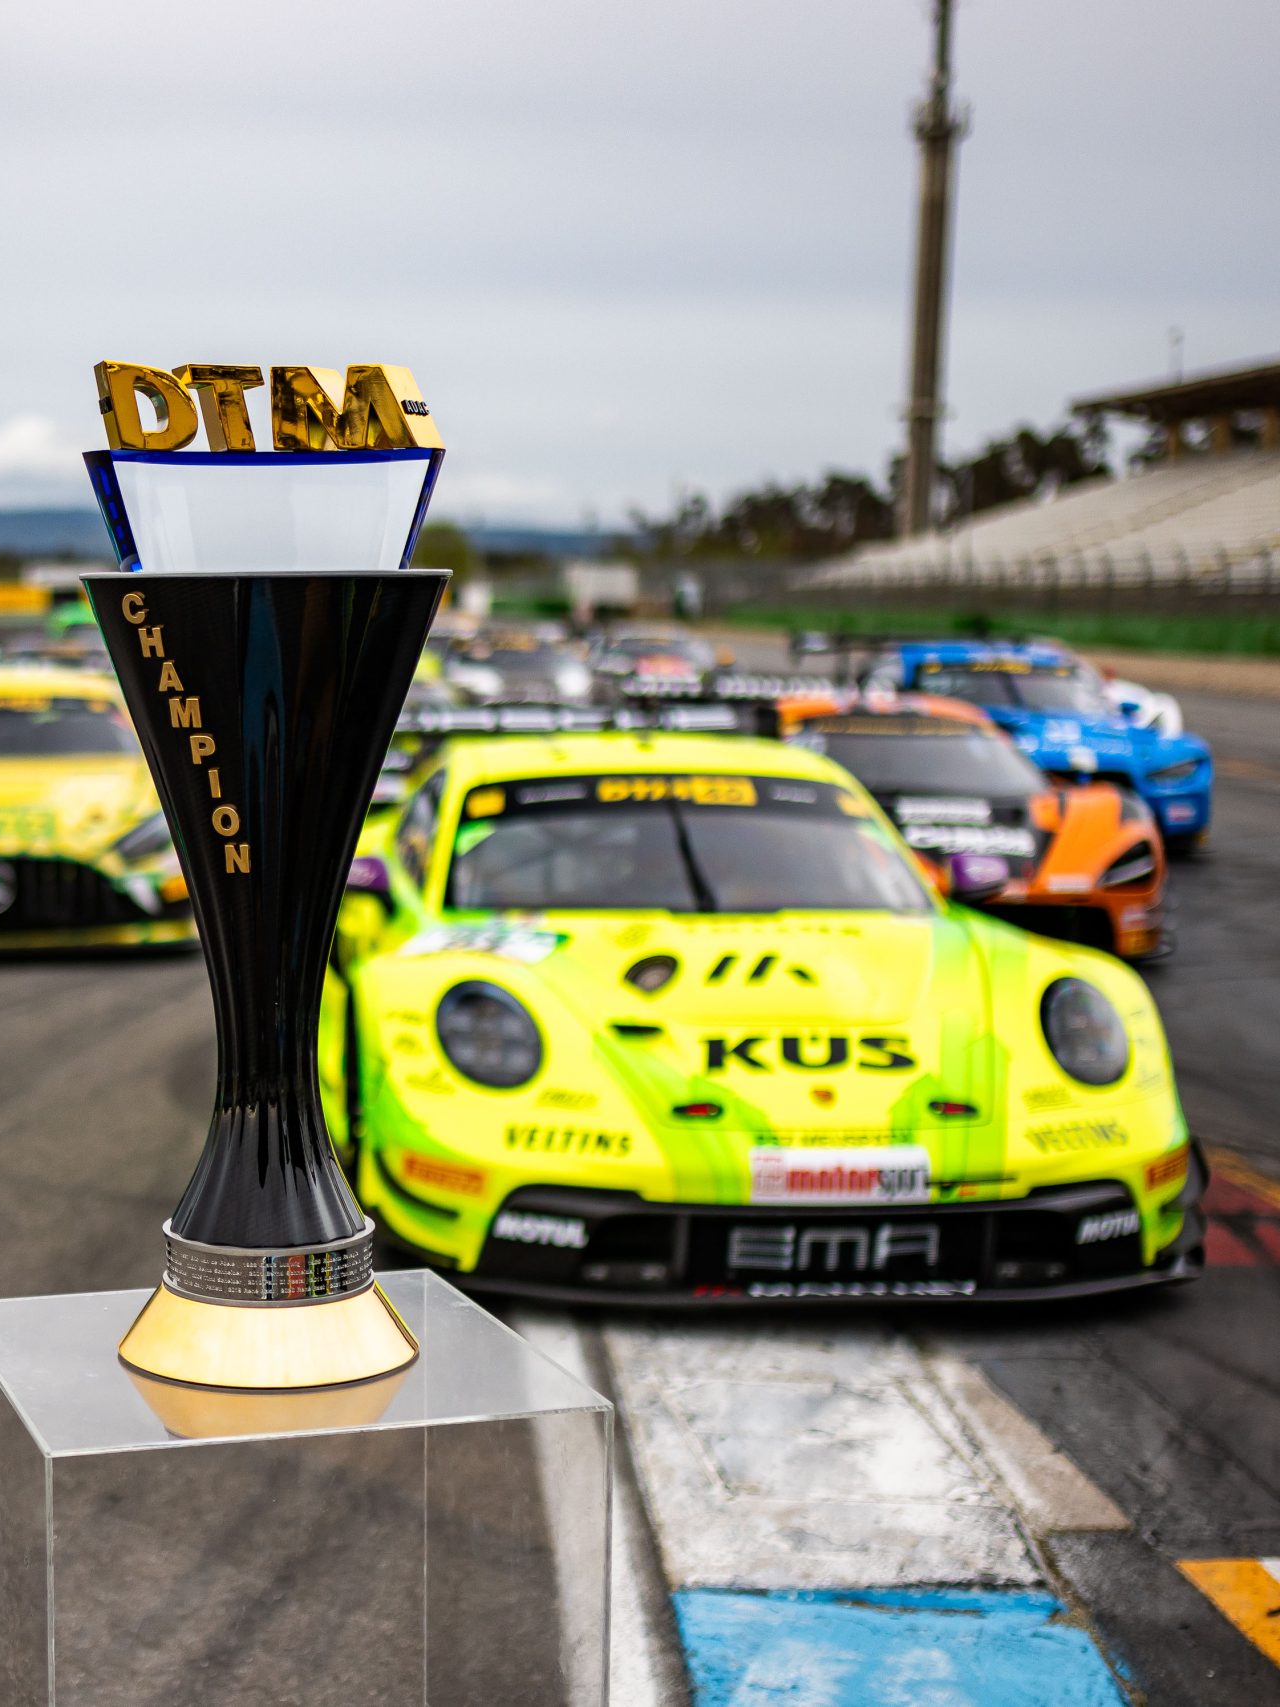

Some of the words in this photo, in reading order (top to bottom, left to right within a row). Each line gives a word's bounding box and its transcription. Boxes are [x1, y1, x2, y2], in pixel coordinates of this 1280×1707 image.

[94, 360, 444, 452] DTM
[122, 591, 251, 873] CHAMPION
[701, 1036, 914, 1075] KÜS
[494, 1213, 588, 1248] MOTUL
[1077, 1209, 1140, 1244] MOTU
